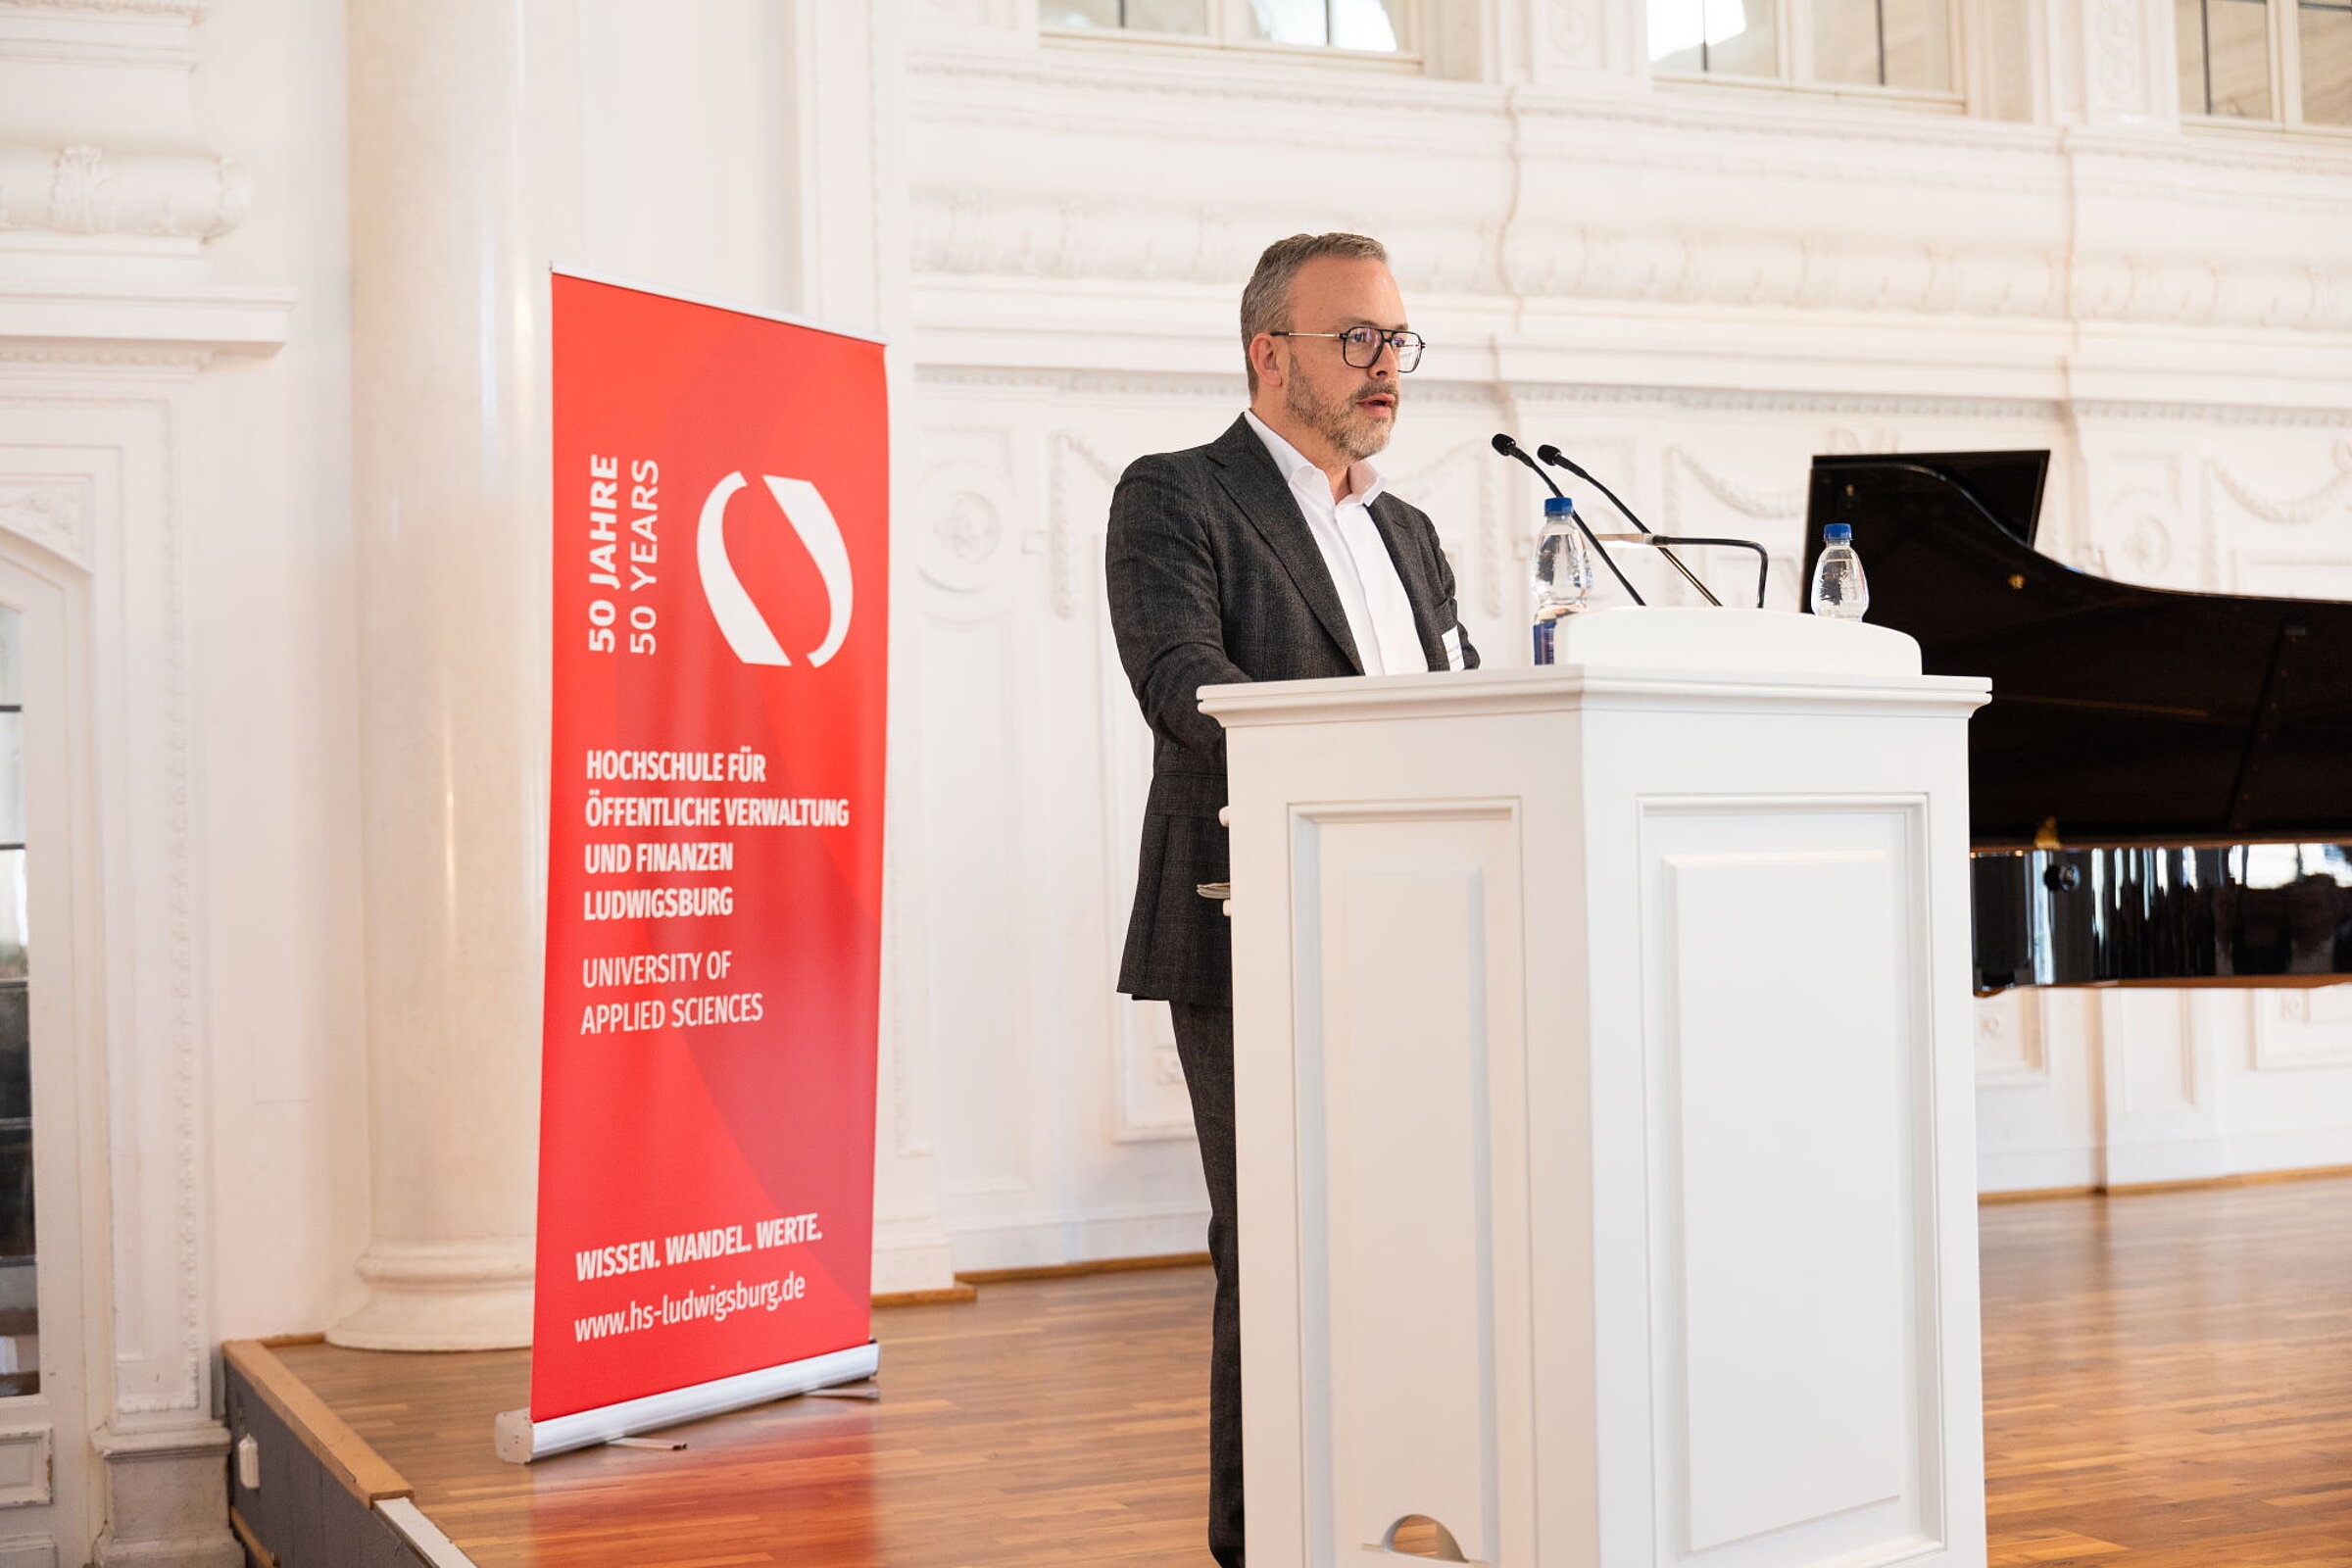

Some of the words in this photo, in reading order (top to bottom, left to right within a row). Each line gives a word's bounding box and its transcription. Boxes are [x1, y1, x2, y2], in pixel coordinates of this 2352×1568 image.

[589, 455, 620, 589] JAHRE
[630, 460, 659, 591] YEARS
[589, 600, 616, 653] 50
[630, 606, 658, 655] 50
[587, 750, 724, 781] HOCHSCHULE
[728, 746, 766, 782] FÜR
[586, 789, 720, 827] ÖFFENTLICHE
[724, 798, 849, 826] VERWALTUNG
[585, 844, 631, 873] UND
[637, 842, 733, 872] FINANZEN
[584, 887, 733, 920] LUDWIGSBURG
[583, 953, 703, 988] UNIVERSITY
[707, 951, 732, 980] OF
[581, 1001, 665, 1035] APPLIED
[671, 993, 763, 1028] SCIENCES
[576, 1241, 661, 1281] WISSEN.
[665, 1225, 752, 1265] WANDEL.
[757, 1213, 822, 1250] WERTE.
[574, 1271, 806, 1343] www.hs-ludwigsburg.de
